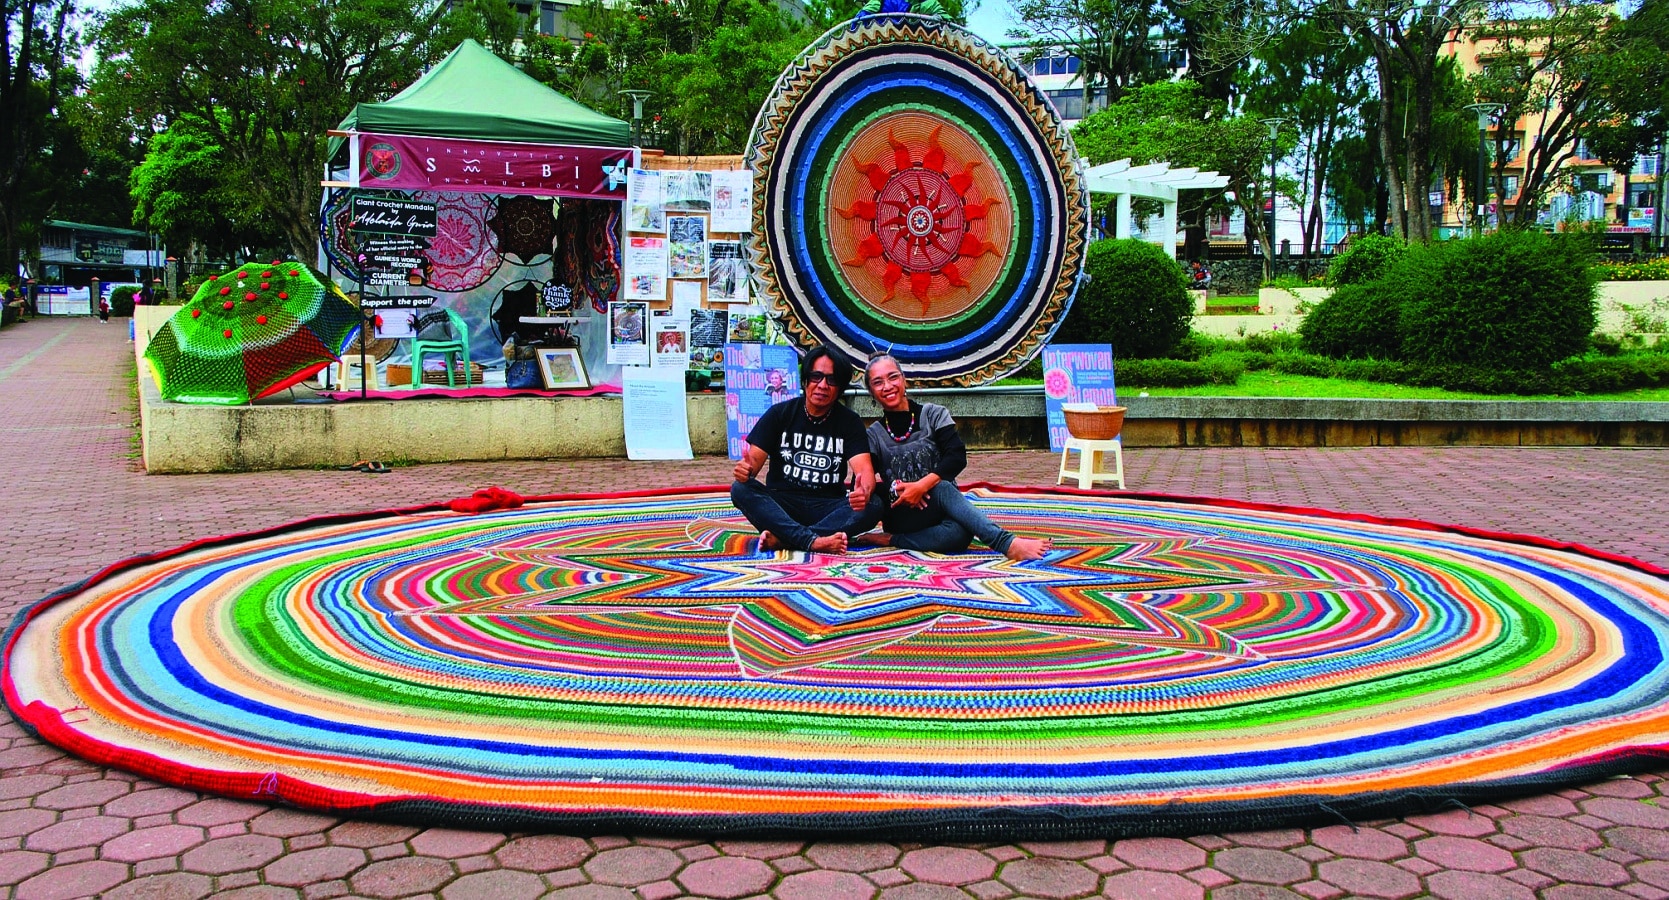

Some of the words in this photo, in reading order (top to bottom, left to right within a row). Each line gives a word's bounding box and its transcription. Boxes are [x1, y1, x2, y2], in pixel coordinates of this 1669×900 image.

[356, 198, 375, 207] Giant
[376, 201, 404, 209] Crochet
[404, 203, 435, 211] Mandala
[370, 278, 410, 286] DIAMETER:
[372, 272, 406, 280] CURRENT
[361, 299, 393, 307] Support
[413, 297, 434, 306] goal!
[726, 346, 745, 366] The
[1043, 349, 1112, 371] Interwoven
[727, 369, 769, 389] Mother
[737, 413, 760, 434] Man
[780, 431, 845, 454] LUCBAN
[799, 453, 827, 467] 1578
[783, 464, 840, 484] QUEZON
